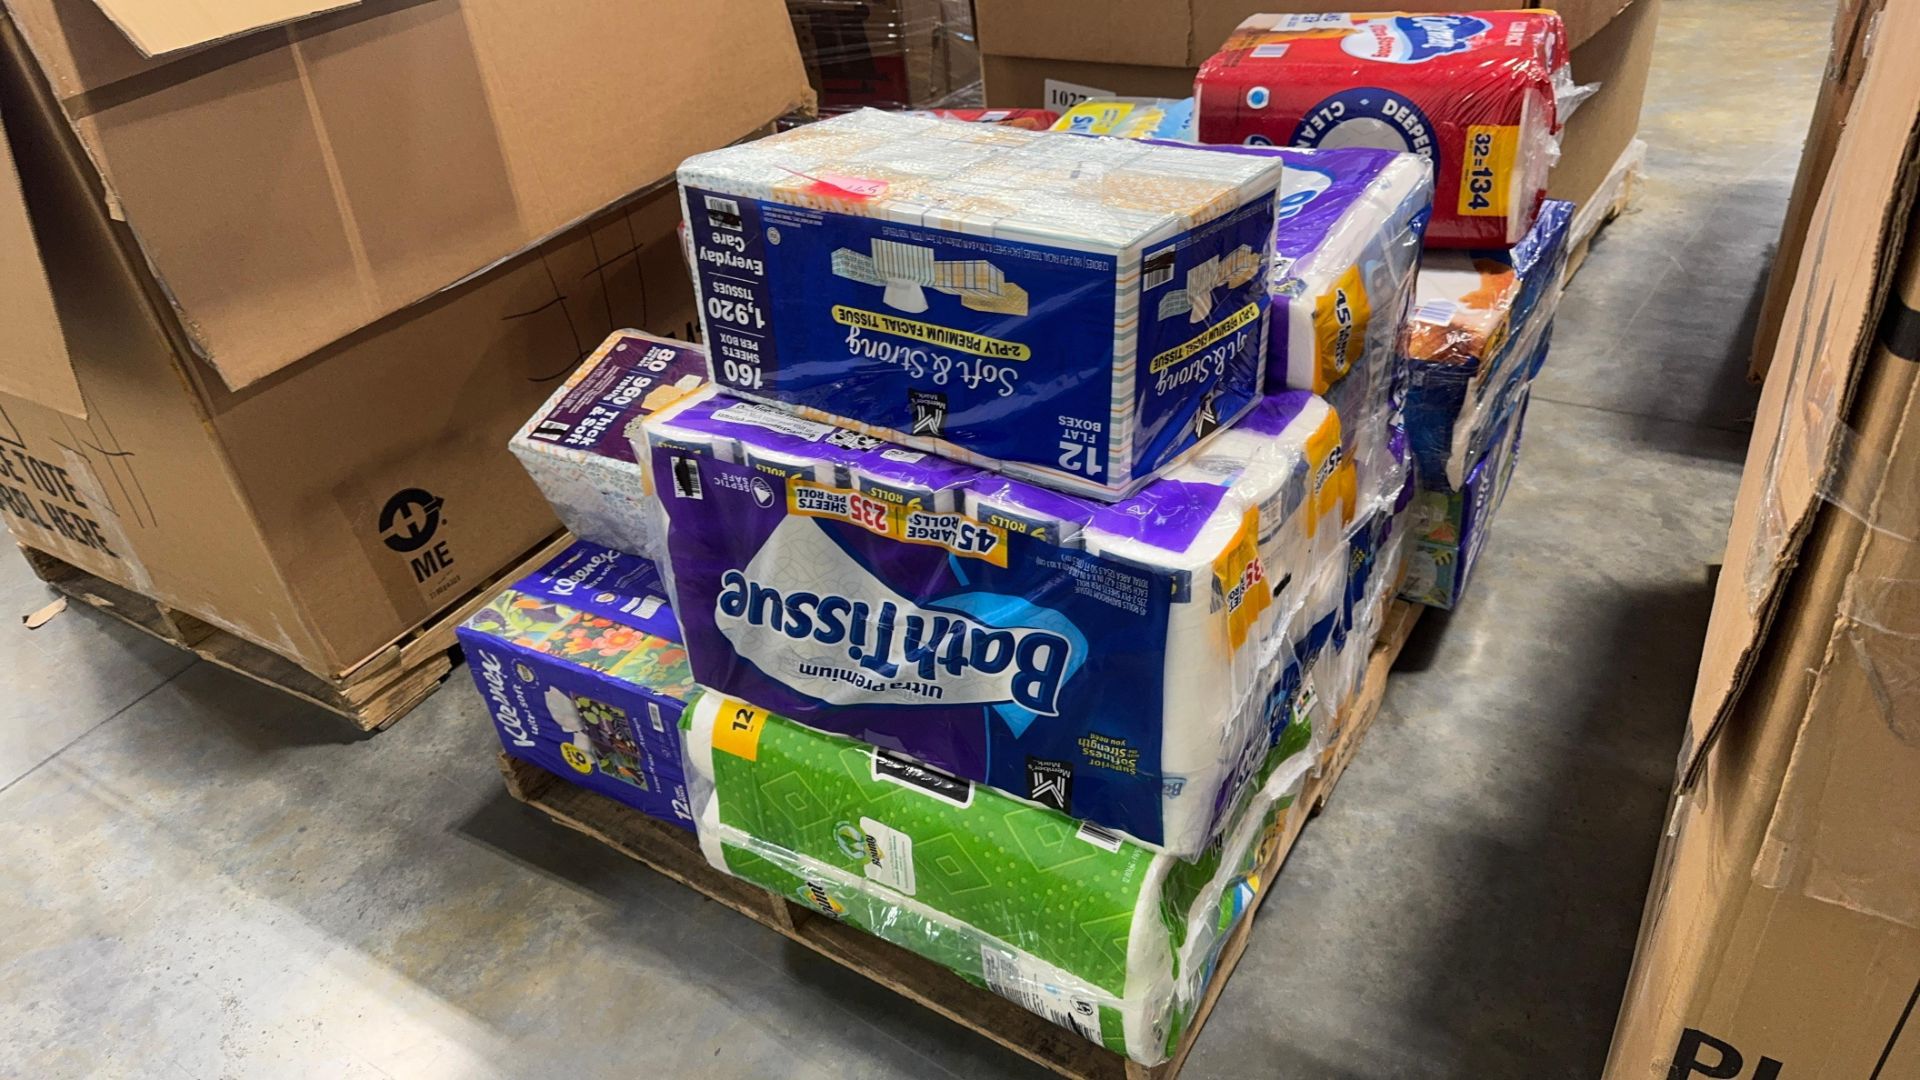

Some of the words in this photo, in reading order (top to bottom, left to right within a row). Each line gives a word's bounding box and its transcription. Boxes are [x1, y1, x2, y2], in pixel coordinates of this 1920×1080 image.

[1382, 98, 1433, 159] DEEPER
[712, 232, 746, 252] Care
[700, 246, 764, 276] Everyday
[713, 282, 754, 300] TISSUES
[708, 297, 766, 329] 1,920
[838, 308, 879, 327] TISSUE
[881, 318, 924, 337] FACIAL
[720, 333, 741, 346] BOX
[741, 338, 759, 351] PER
[928, 327, 982, 351] PREMIUM
[984, 341, 1021, 357] 2-PLY
[647, 348, 676, 372] 80
[722, 346, 760, 364] SHEETS
[845, 326, 928, 378] Strong
[1153, 347, 1184, 370] TISSUE
[723, 360, 764, 390] 160
[930, 353, 952, 385] &
[955, 359, 1019, 397] Soft
[1155, 355, 1213, 396] Strong
[612, 376, 652, 405] 960
[588, 406, 606, 416] &
[564, 417, 596, 444] Soft
[579, 410, 620, 446] Thick
[1058, 416, 1102, 432] BOXES
[1062, 429, 1096, 444] FLAT
[1058, 441, 1103, 476] 12
[14, 451, 88, 509] TOTE
[713, 477, 750, 492] SEPTIC
[722, 473, 749, 484] SAFE
[796, 488, 825, 500] ROLL
[826, 492, 847, 503] PER
[869, 487, 903, 503] ROLLS
[798, 498, 847, 514] SHEETS
[850, 494, 887, 531] 235
[40, 499, 120, 559] HERE
[988, 514, 1027, 532] ROLLS
[907, 526, 957, 547] LARGE
[957, 521, 997, 555] 45
[410, 541, 454, 584] ME
[548, 550, 621, 596] Kleenex
[798, 663, 886, 693] Premium
[889, 682, 943, 700] Ultra
[732, 708, 754, 732] 12
[1078, 738, 1127, 757] Strength
[1082, 747, 1137, 767] Softness
[1027, 763, 1071, 778] Member's
[1088, 758, 1137, 776] Superior
[671, 799, 693, 821] 12
